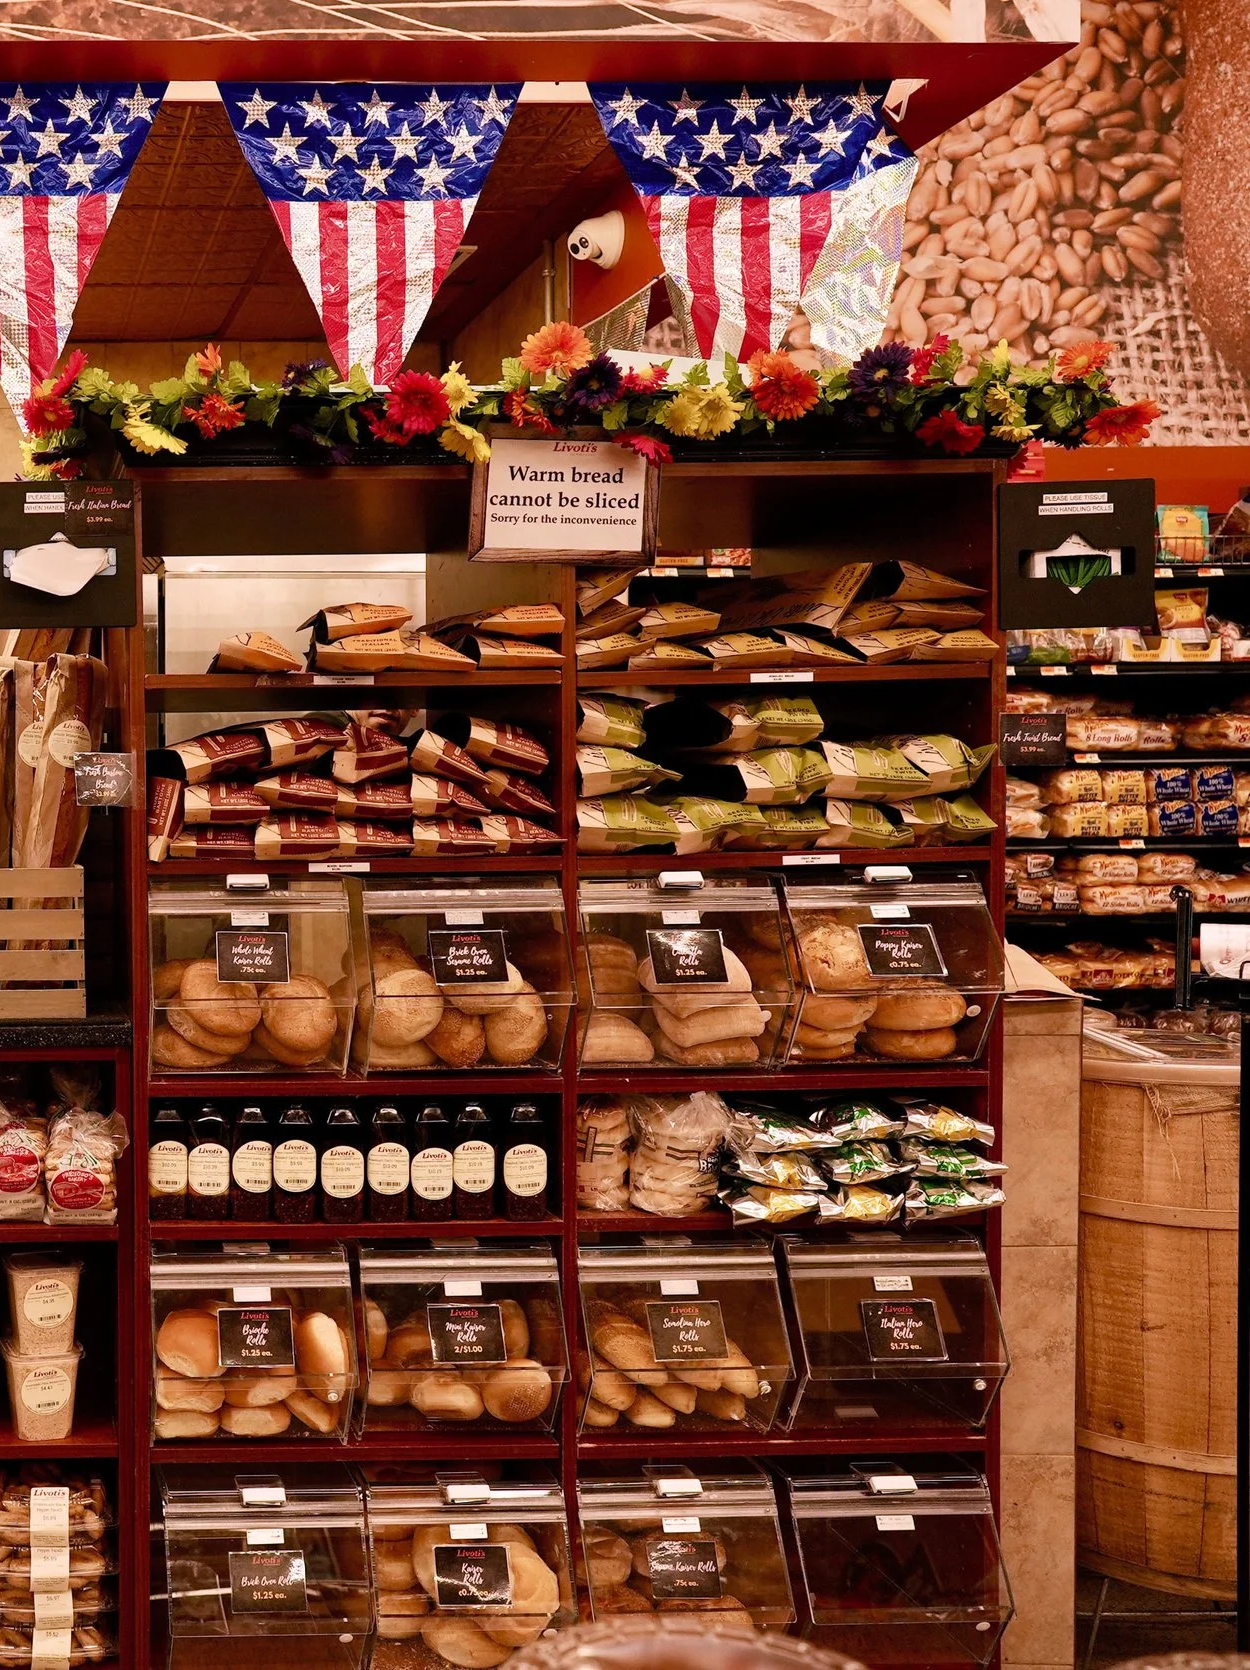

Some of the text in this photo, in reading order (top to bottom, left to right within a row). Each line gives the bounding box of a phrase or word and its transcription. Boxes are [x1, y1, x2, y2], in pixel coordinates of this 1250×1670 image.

[508, 465, 624, 484] Warm bread
[489, 492, 640, 509] cannot be sliced
[1044, 493, 1107, 502] PLEASE USE TISSUE
[67, 499, 132, 510] Fresh Italian Bread
[1039, 504, 1113, 514] WHEN HANDLING ROLLS
[490, 513, 637, 525] Sorry for the inconvenience
[1003, 730, 1063, 742] Fresh Twist Bread
[1091, 734, 1133, 744] Long Rolls
[232, 944, 274, 955] Whole Wheat
[449, 946, 488, 956] Brick Oven
[875, 940, 924, 951] Poppy Kaiser
[891, 947, 912, 959] Rolls
[233, 955, 274, 966] Kaiser Rolls
[446, 954, 494, 966] Sesame Rolls
[678, 953, 699, 966] Rolls
[455, 968, 475, 976] $1.25
[675, 969, 695, 977] $1.25
[242, 1322, 269, 1335] Brioche
[445, 1321, 486, 1333] Mini Kaiser
[662, 1317, 711, 1329] Semolina Hero
[880, 1317, 923, 1329] Italian Hero
[457, 1331, 478, 1343] Rolls
[679, 1329, 700, 1342] Rolls
[893, 1327, 914, 1340] Rolls
[246, 1334, 267, 1346] Rolls
[890, 1342, 910, 1350] $1.75
[241, 1348, 260, 1357] $1.25
[454, 1345, 483, 1354] 2/$1.00
[672, 1344, 693, 1353] $1.75
[33, 1489, 67, 1497] Livoti's
[461, 1563, 484, 1573] Kaiser
[675, 1561, 697, 1572] Kaiser
[697, 1560, 717, 1573] Rolls
[241, 1575, 277, 1587] Brick Oven
[463, 1573, 484, 1585] Rolls
[252, 1591, 273, 1600] $1.25
